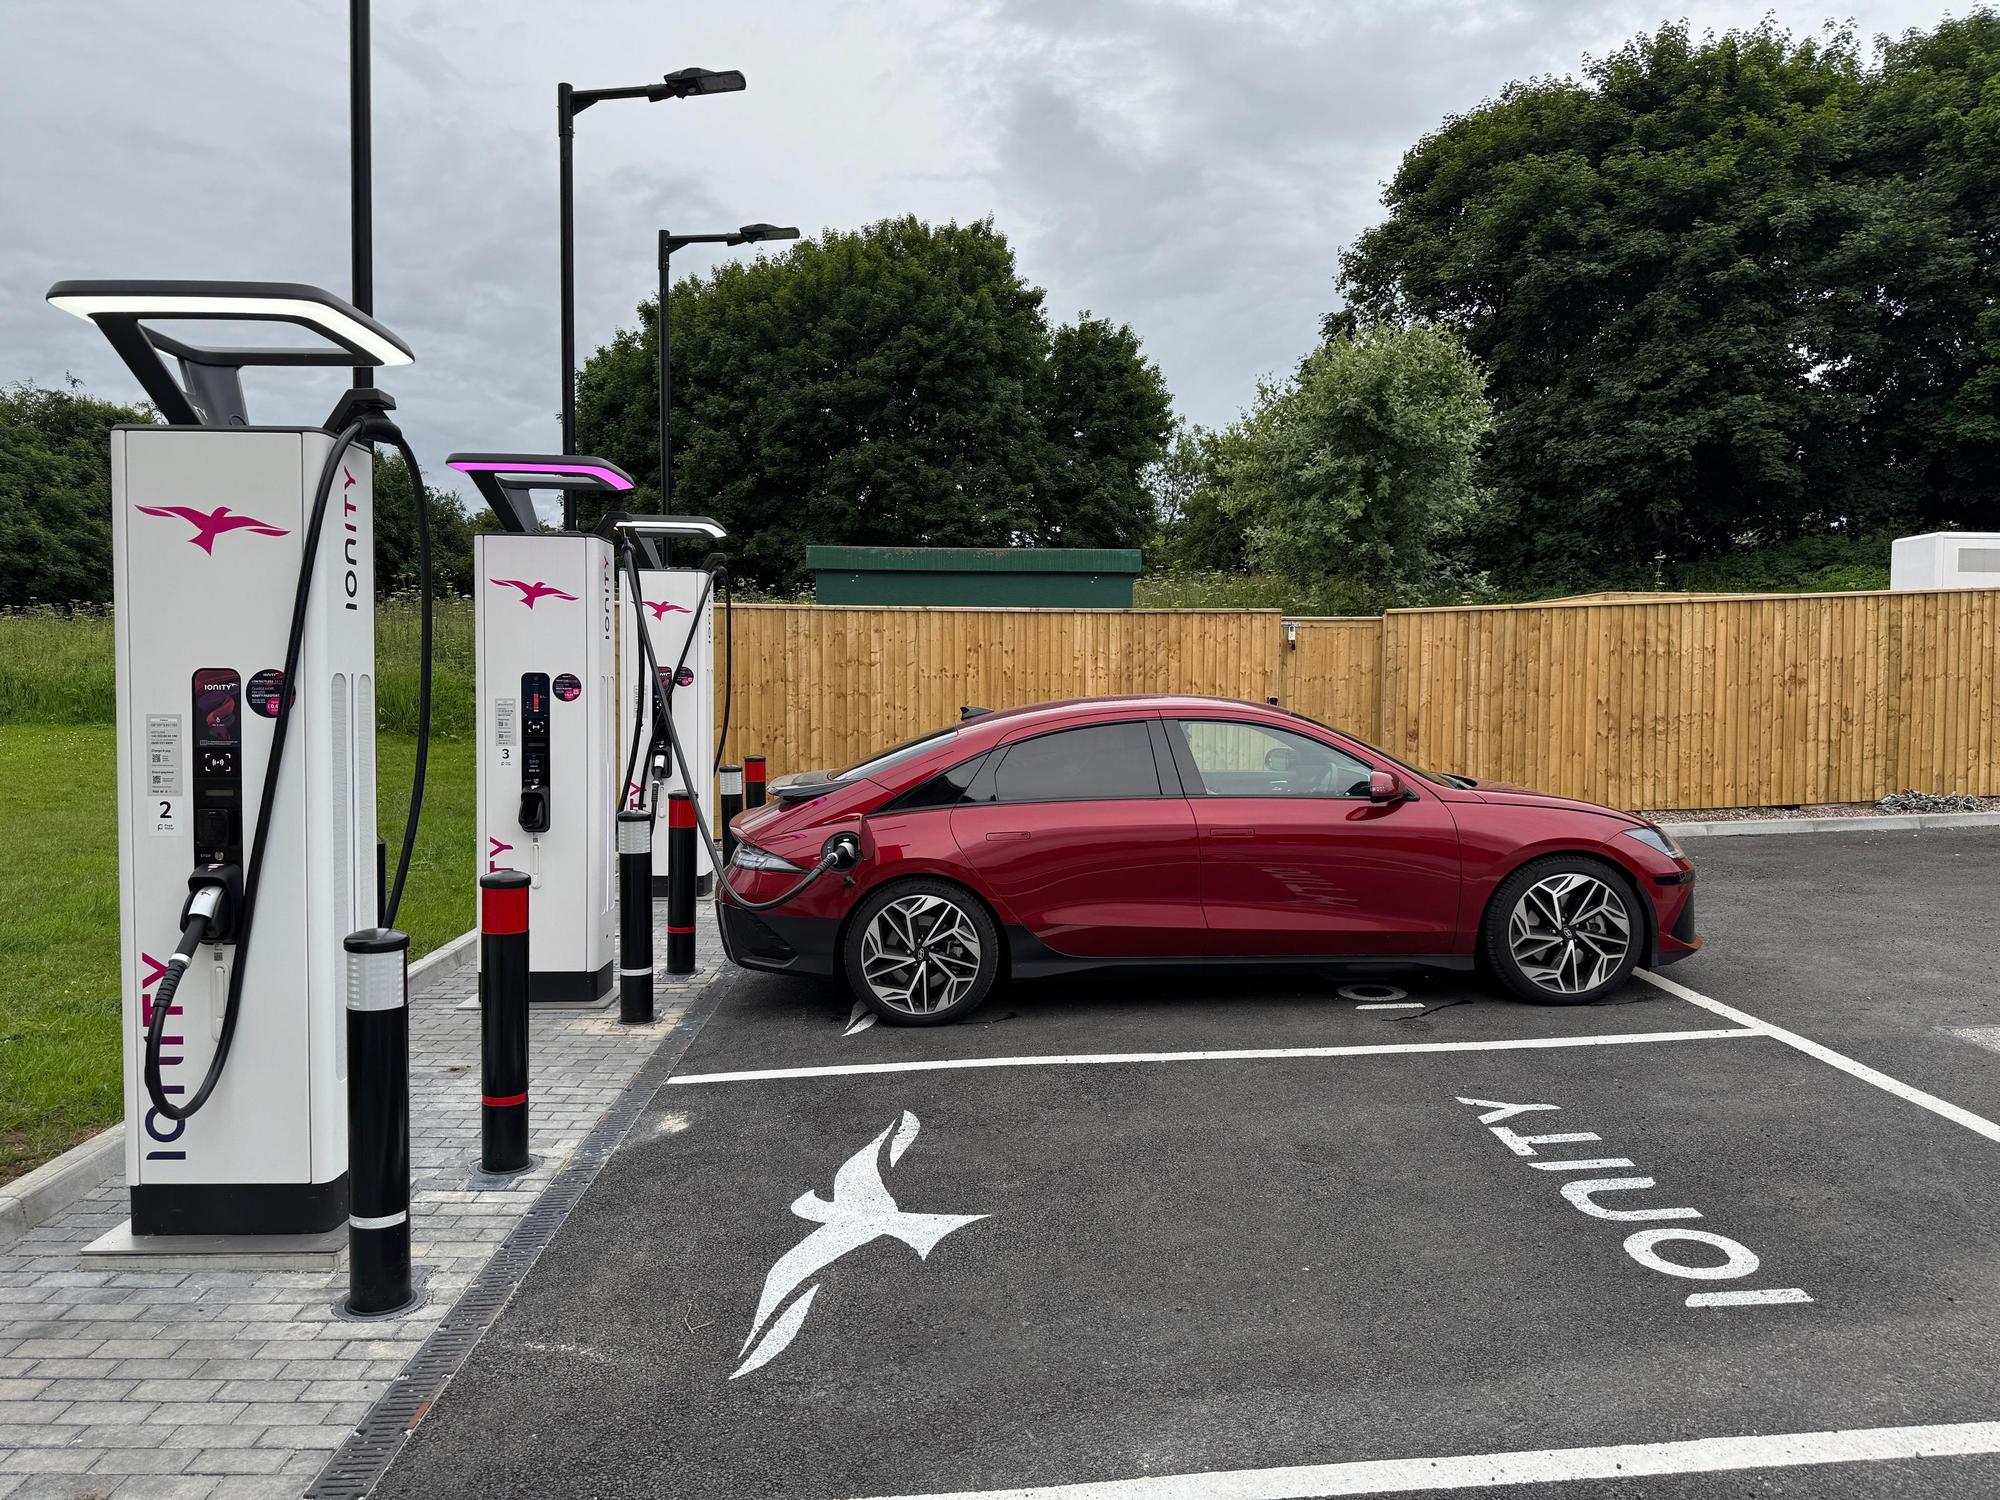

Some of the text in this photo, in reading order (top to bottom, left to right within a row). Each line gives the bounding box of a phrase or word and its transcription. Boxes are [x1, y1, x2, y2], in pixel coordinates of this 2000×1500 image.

[343, 465, 358, 611] IONITY
[502, 748, 510, 760] 3
[159, 801, 172, 819] 2
[1454, 1096, 1815, 1308] IONITY
